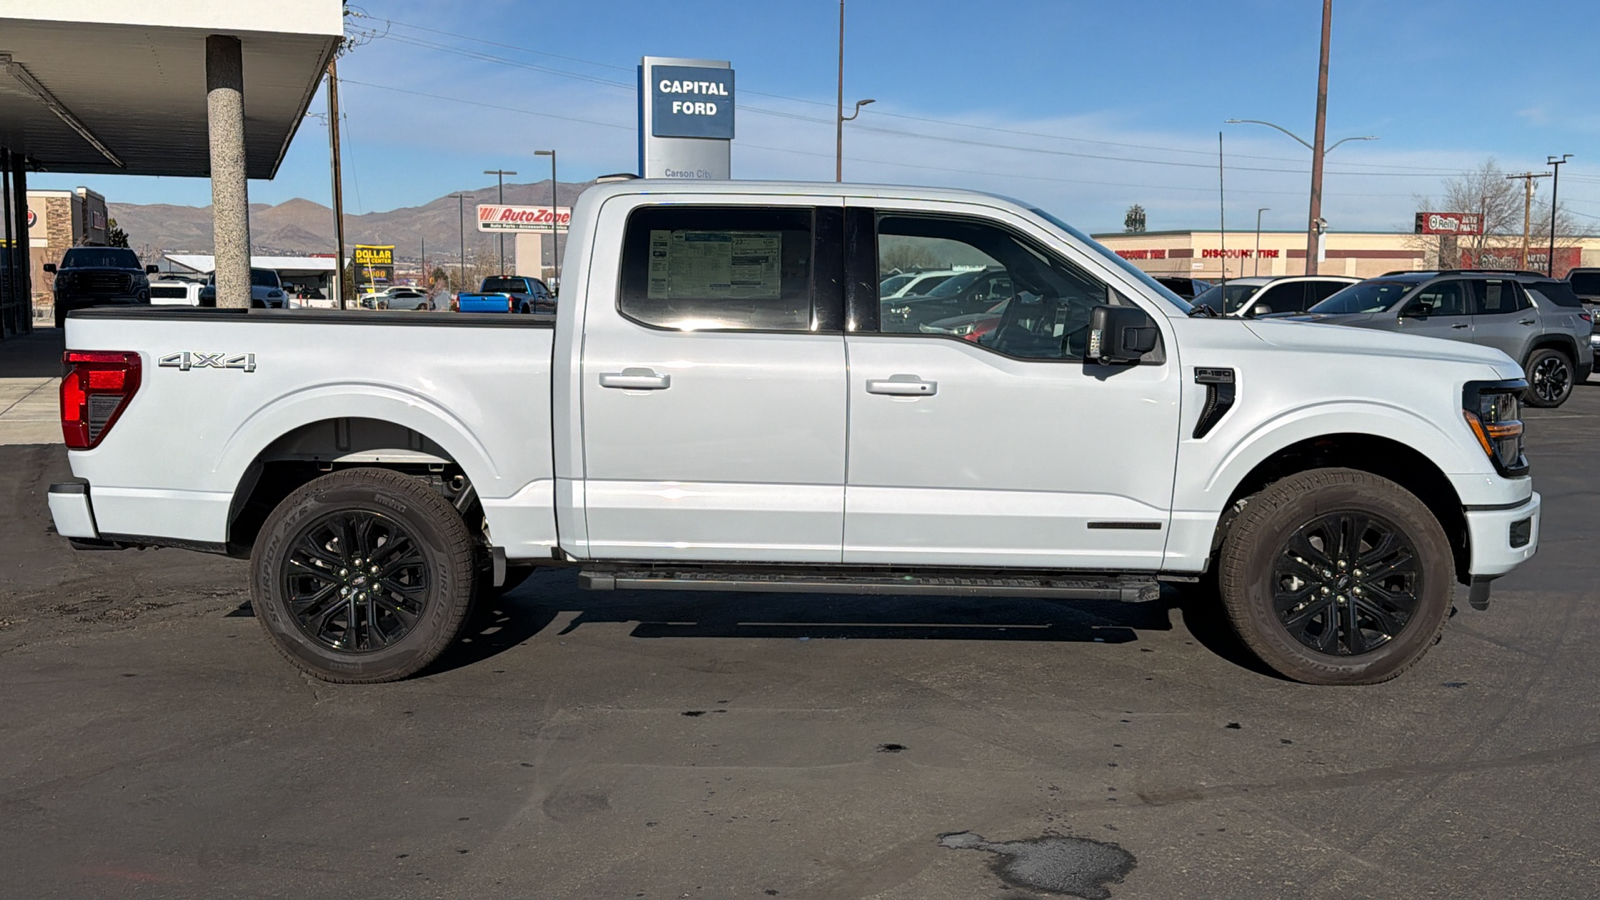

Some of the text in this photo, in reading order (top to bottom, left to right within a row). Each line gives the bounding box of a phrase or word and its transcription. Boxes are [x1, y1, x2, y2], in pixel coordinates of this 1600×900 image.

[659, 80, 728, 96] CAPITAL
[672, 101, 717, 116] FORD
[664, 168, 713, 179] Carson City
[499, 208, 570, 223] AutoZone
[1429, 215, 1459, 232] O'Reilly
[355, 250, 391, 258] DOLLAR
[1150, 250, 1166, 259] TIRE
[1202, 249, 1279, 258] DISCOUNT TIRE
[262, 535, 281, 623] SCORPION
[431, 562, 448, 628] PIRELLI
